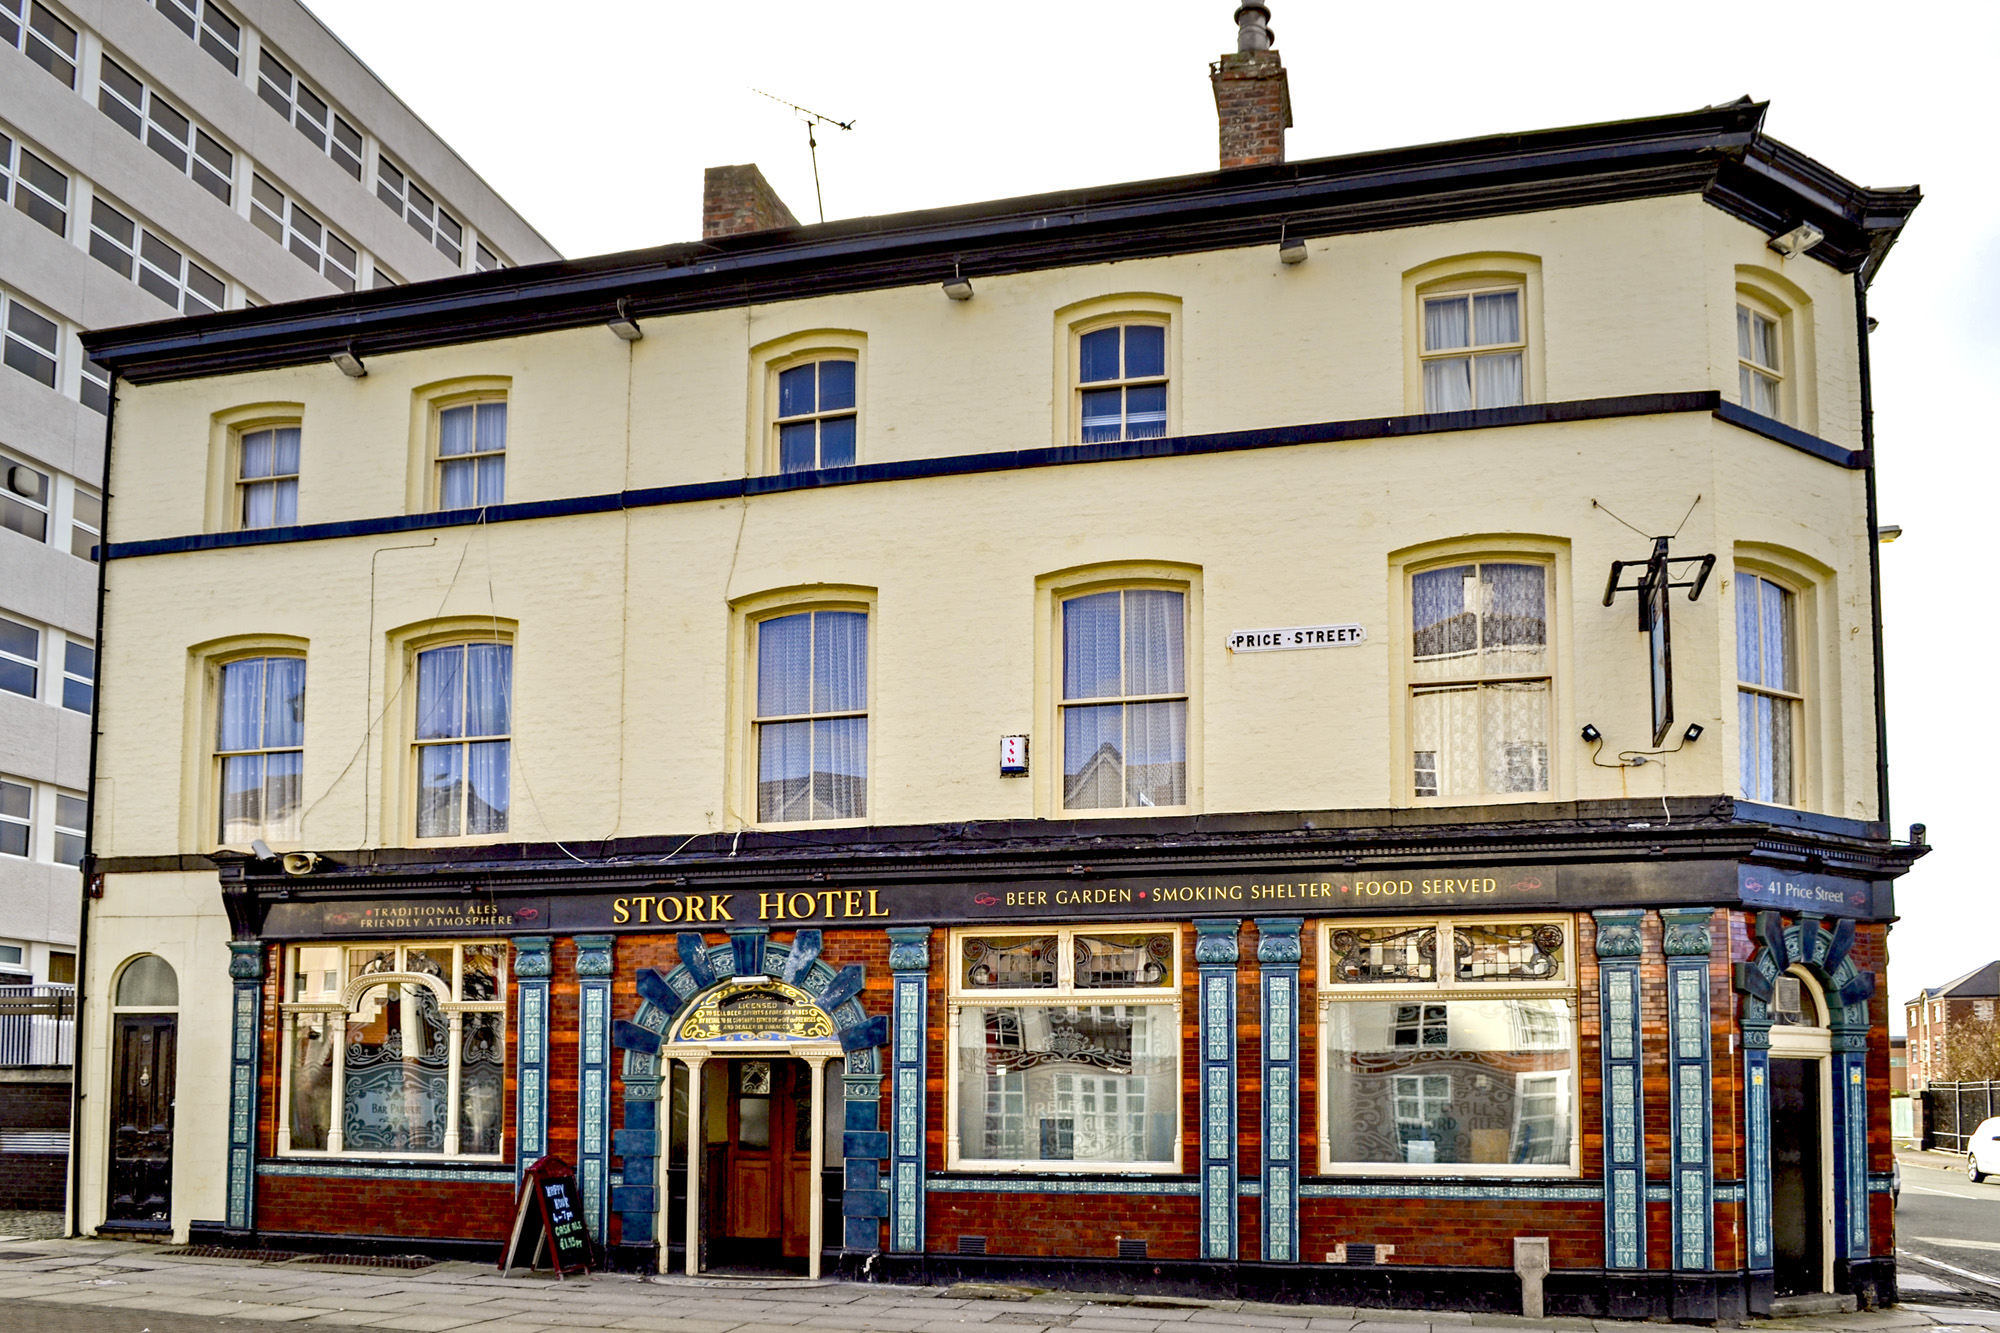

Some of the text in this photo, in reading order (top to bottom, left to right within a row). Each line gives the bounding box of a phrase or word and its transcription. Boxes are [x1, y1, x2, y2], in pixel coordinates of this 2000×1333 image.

[1236, 628, 1357, 648] PRICE STREET
[1006, 878, 1497, 906] BEER GARDEN SMOKING SHELTER FOOD SERVED
[1768, 881, 1844, 903] 41 Price Street
[374, 904, 498, 917] TRADITIONAL ALES
[613, 889, 889, 924] STORK HOTEL
[360, 915, 513, 928] FRIENDLY ATMOSPHERE
[371, 1103, 388, 1115] BAR
[1468, 1116, 1506, 1131] ALES
